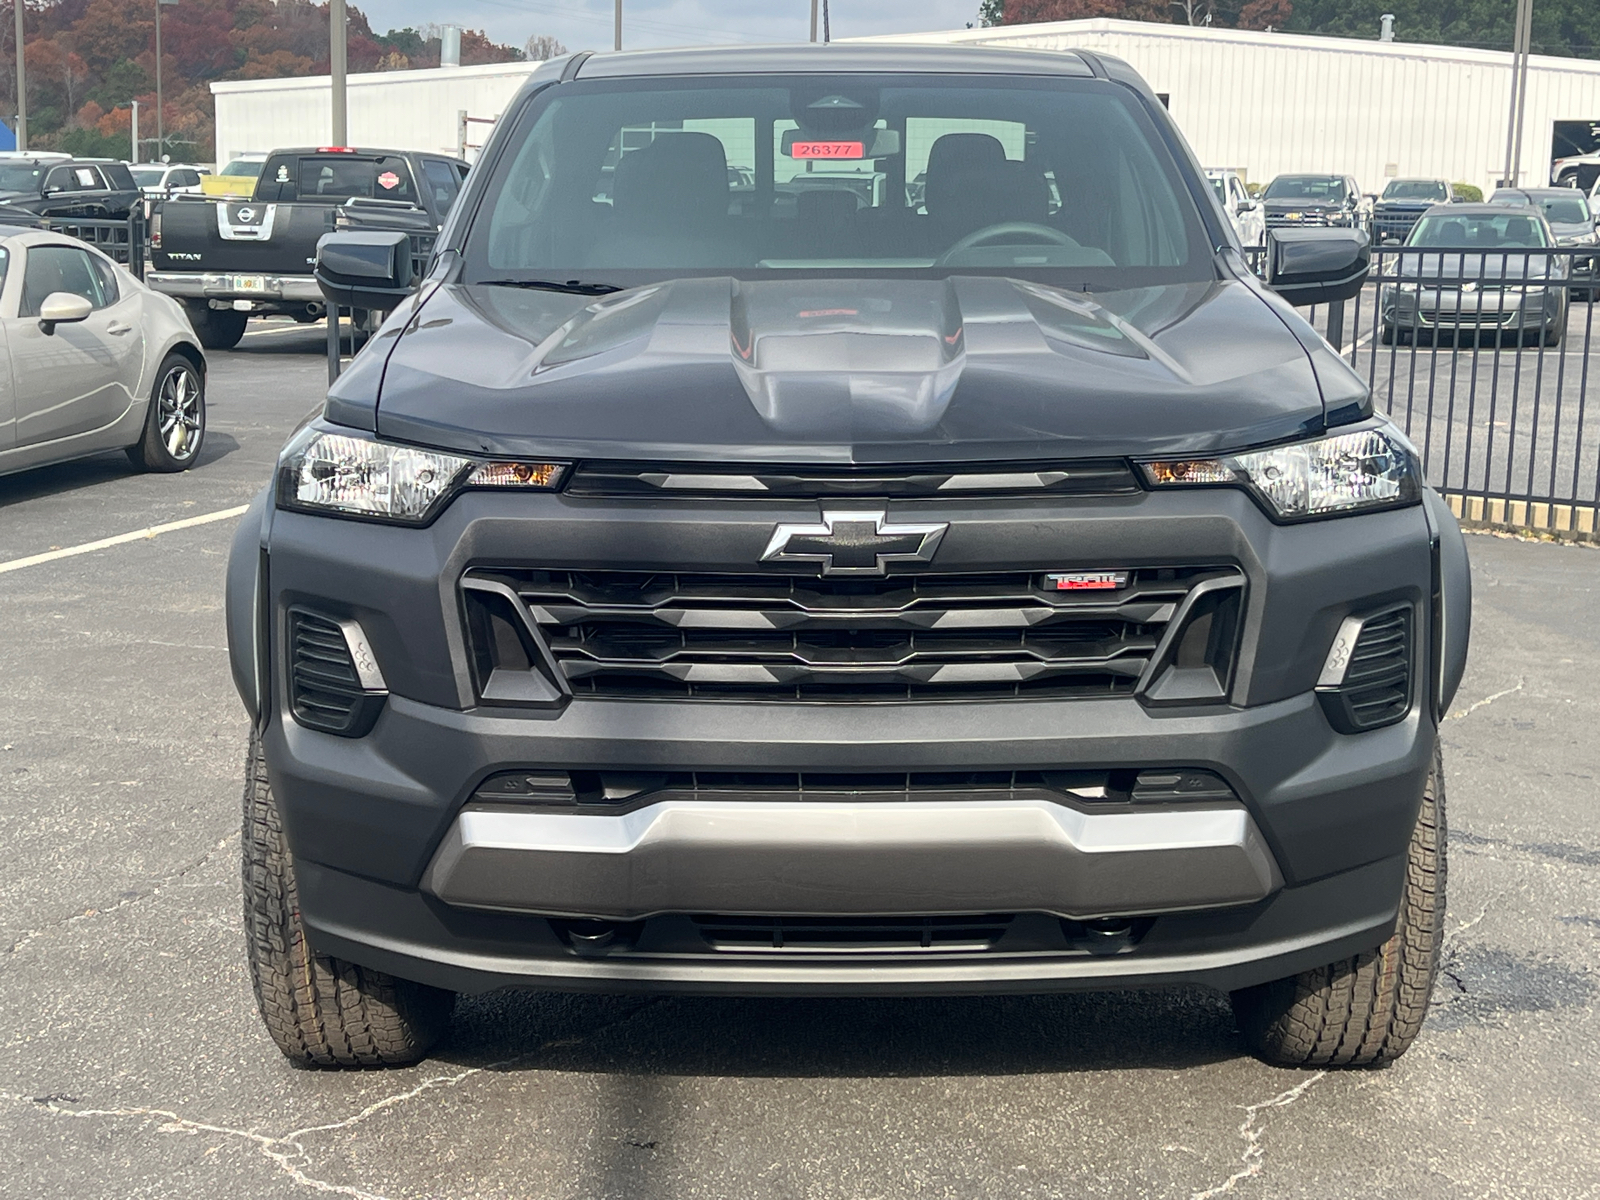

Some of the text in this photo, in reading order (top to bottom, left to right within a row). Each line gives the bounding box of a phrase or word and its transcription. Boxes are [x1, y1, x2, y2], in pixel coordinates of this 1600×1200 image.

[800, 144, 853, 156] 26377
[167, 252, 202, 261] TITAN
[1047, 572, 1126, 583] TRAIL
